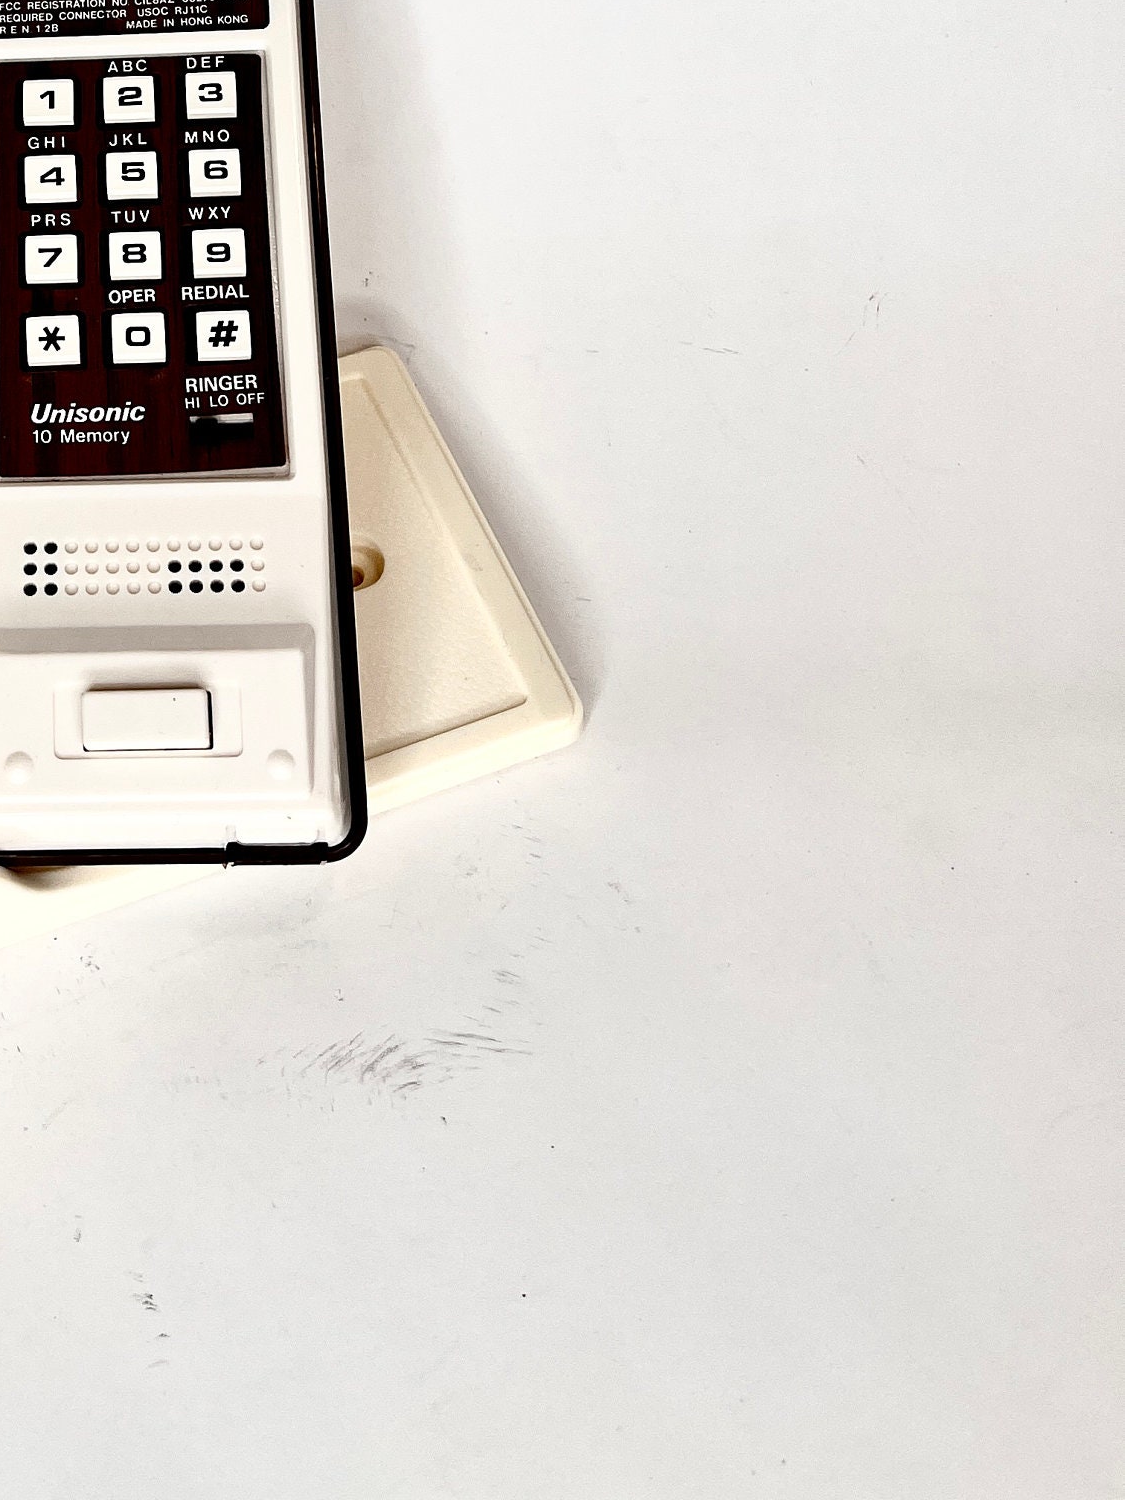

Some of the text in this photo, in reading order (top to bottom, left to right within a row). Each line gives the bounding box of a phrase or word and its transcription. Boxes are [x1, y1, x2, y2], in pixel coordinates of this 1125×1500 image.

[27, 0, 106, 10] REGISTRATION
[0, 4, 208, 23] REQUIRED CONNECTOR USOC RJ11C
[125, 14, 249, 29] MADE IN HONG KONG
[107, 59, 148, 73] ABC
[186, 55, 225, 70] DEF
[118, 87, 142, 106] 2
[199, 83, 222, 101] 3
[40, 91, 54, 109] 1
[28, 137, 64, 149] GHI
[109, 133, 147, 146] JKL
[185, 129, 229, 143] MNO
[40, 167, 65, 185] 4
[122, 162, 145, 181] 5
[204, 160, 228, 179] 6
[31, 213, 70, 226] PRS
[111, 210, 149, 223] TUV
[189, 206, 230, 220] WXY
[38, 248, 62, 267] 7
[123, 244, 146, 263] 8
[207, 243, 230, 262] 9
[109, 289, 155, 303] OPER
[182, 284, 249, 300] REDIAL
[185, 373, 258, 393] RINGER
[185, 393, 264, 408] HI LO OFF
[31, 402, 145, 423] Unisonic
[33, 429, 129, 444] 10 Memory
